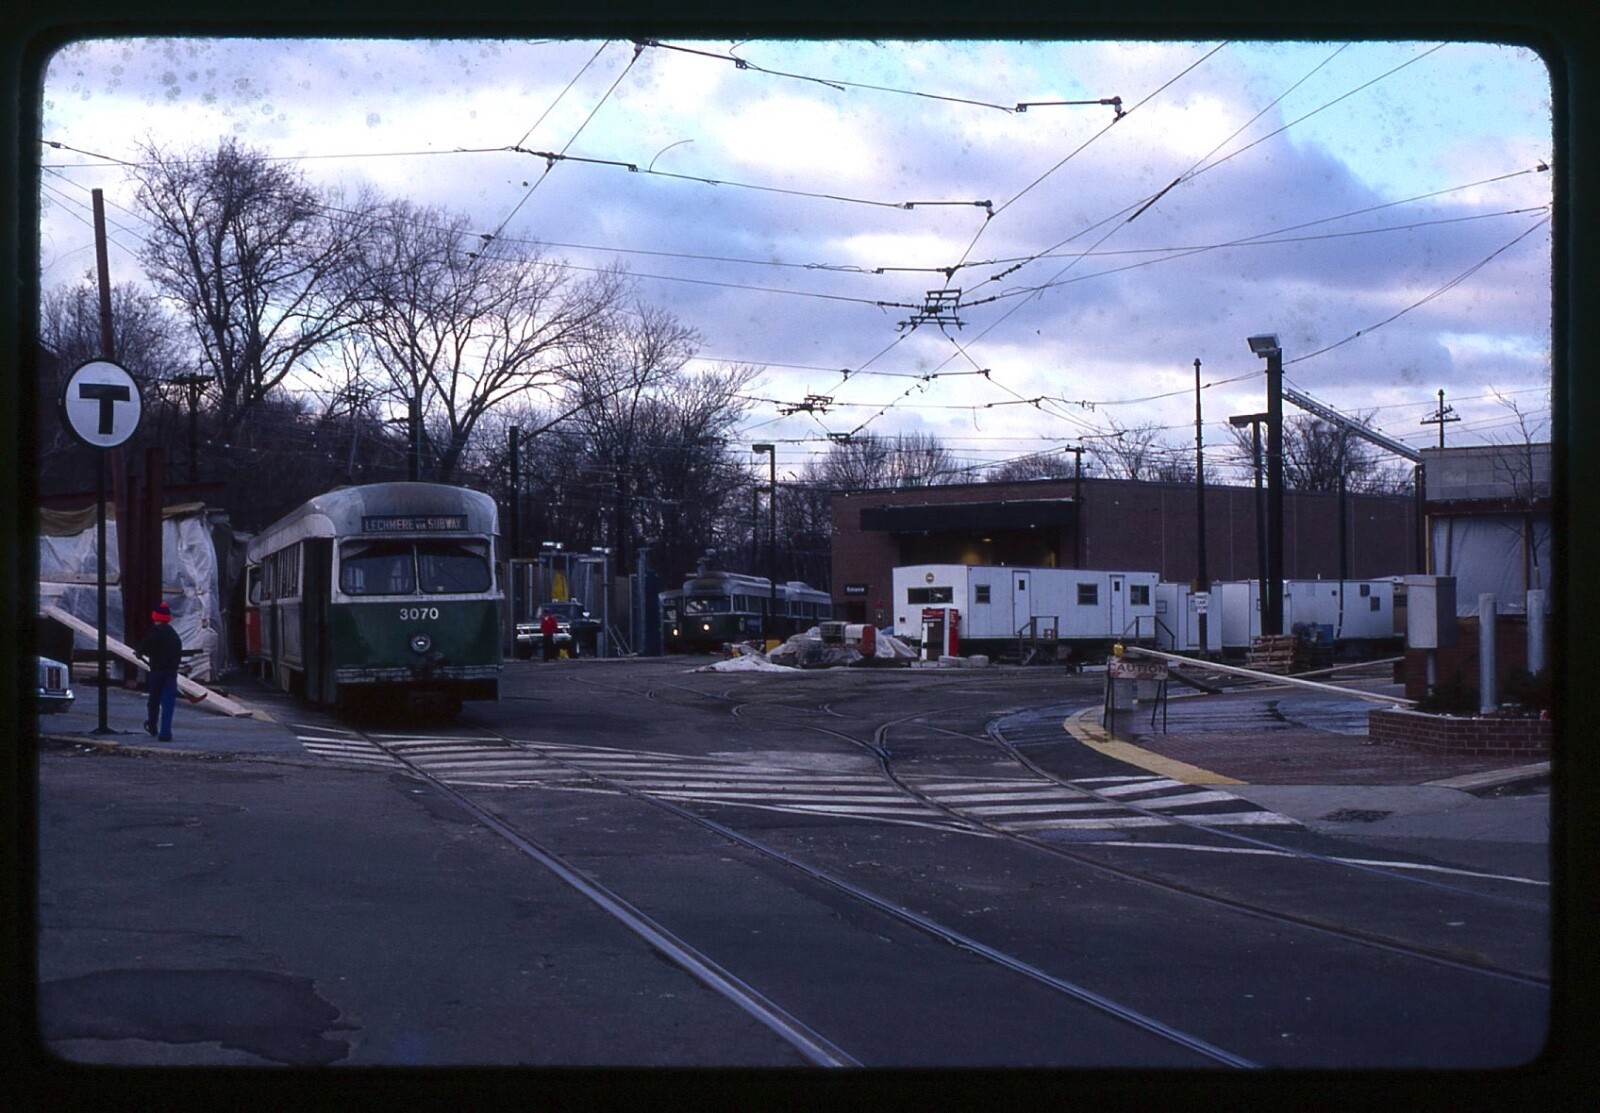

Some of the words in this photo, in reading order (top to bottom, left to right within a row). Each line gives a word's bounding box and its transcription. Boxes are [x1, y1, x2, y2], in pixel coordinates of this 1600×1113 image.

[79, 383, 130, 434] T
[365, 518, 413, 531] LECHMERE
[427, 517, 460, 529] SUBWAY
[400, 607, 439, 620] 3070
